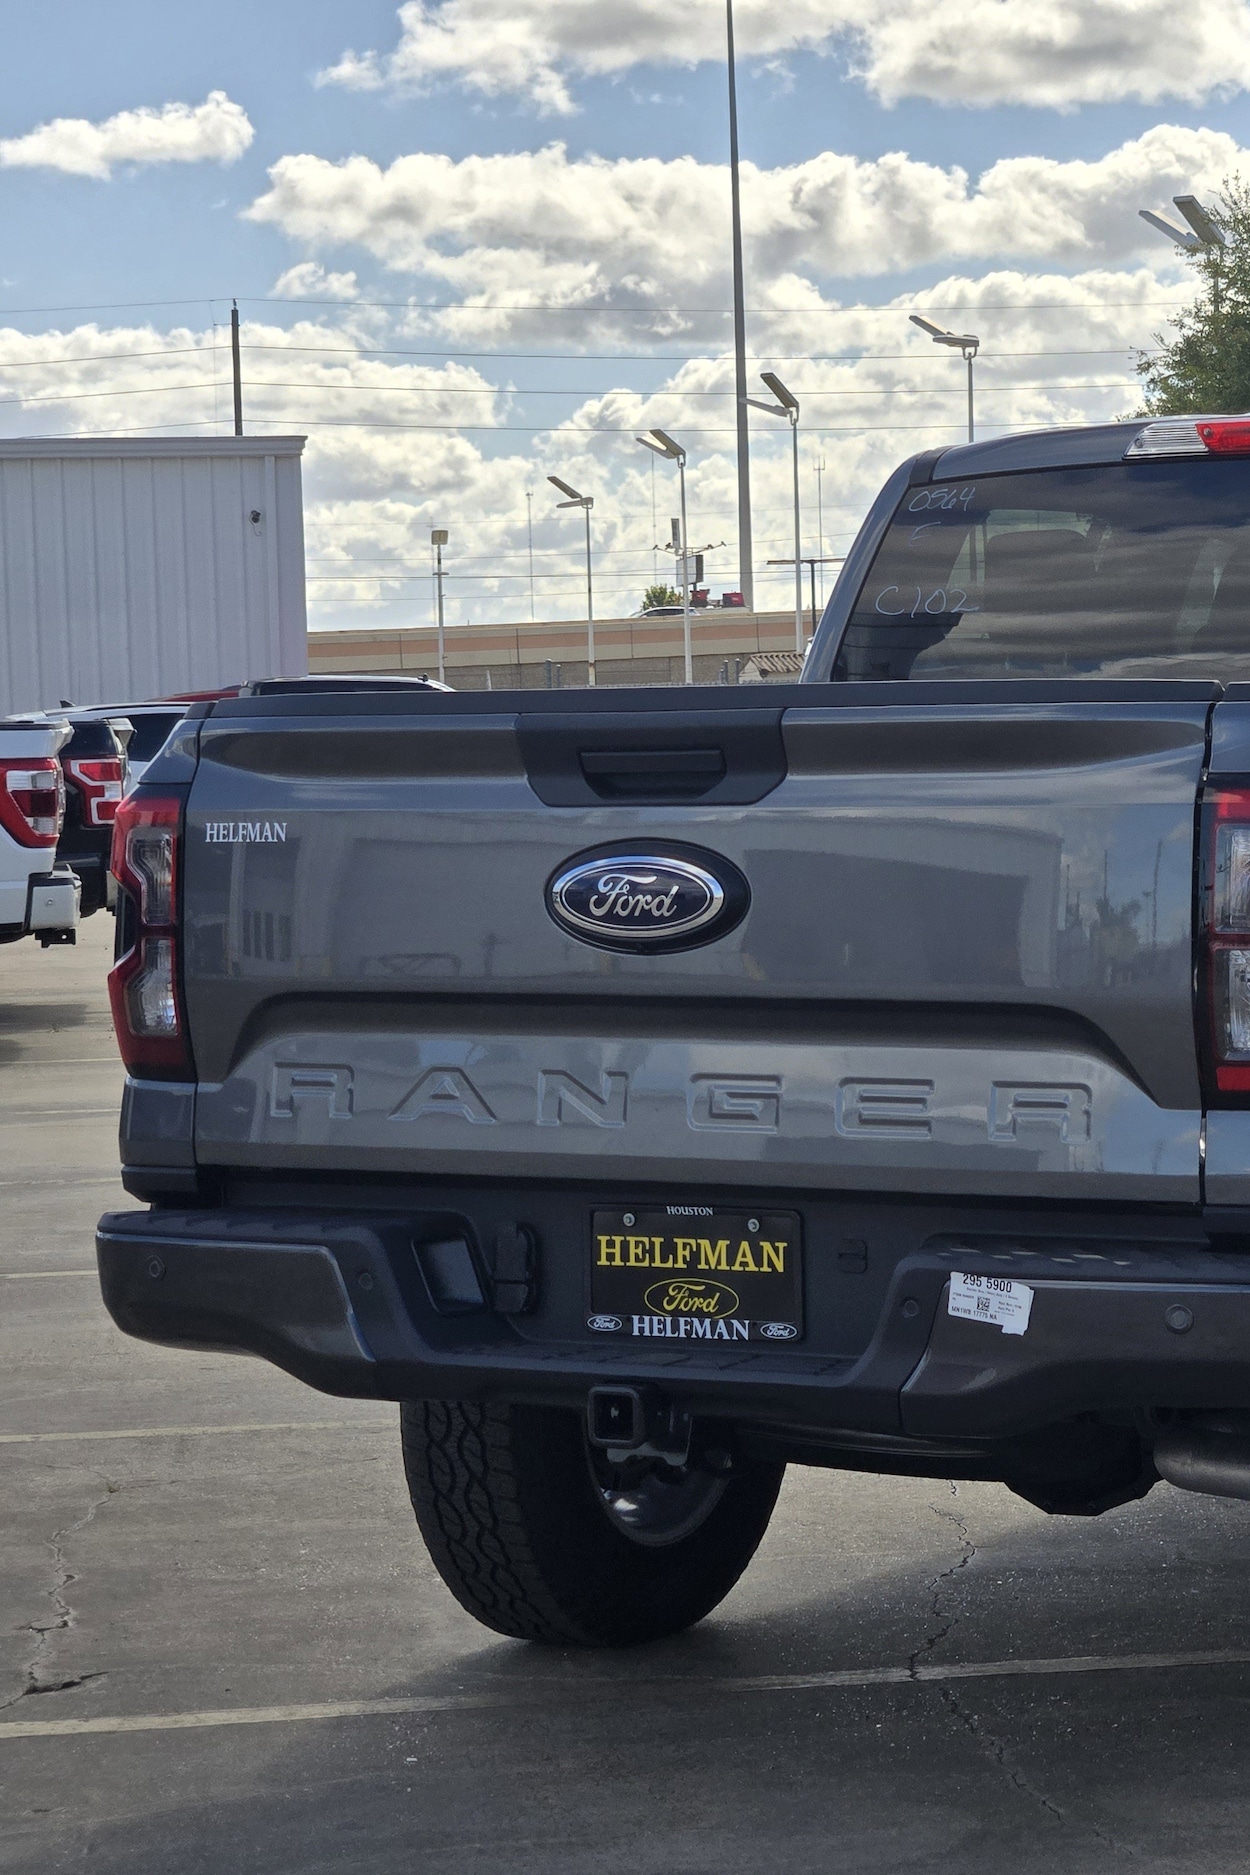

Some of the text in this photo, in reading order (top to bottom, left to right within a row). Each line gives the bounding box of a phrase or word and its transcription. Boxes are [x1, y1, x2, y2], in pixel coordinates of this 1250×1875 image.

[205, 822, 287, 843] HELFMAN
[589, 872, 680, 919] Ford
[269, 1061, 1094, 1145] RANGER
[666, 1205, 714, 1217] HOUSTON
[596, 1235, 788, 1273] HELFMAN
[962, 1273, 1012, 1293] 295 5900
[662, 1282, 721, 1313] Ford
[593, 1316, 616, 1329] Ford
[631, 1315, 751, 1341] HELFMAN
[766, 1325, 791, 1338] Ford
